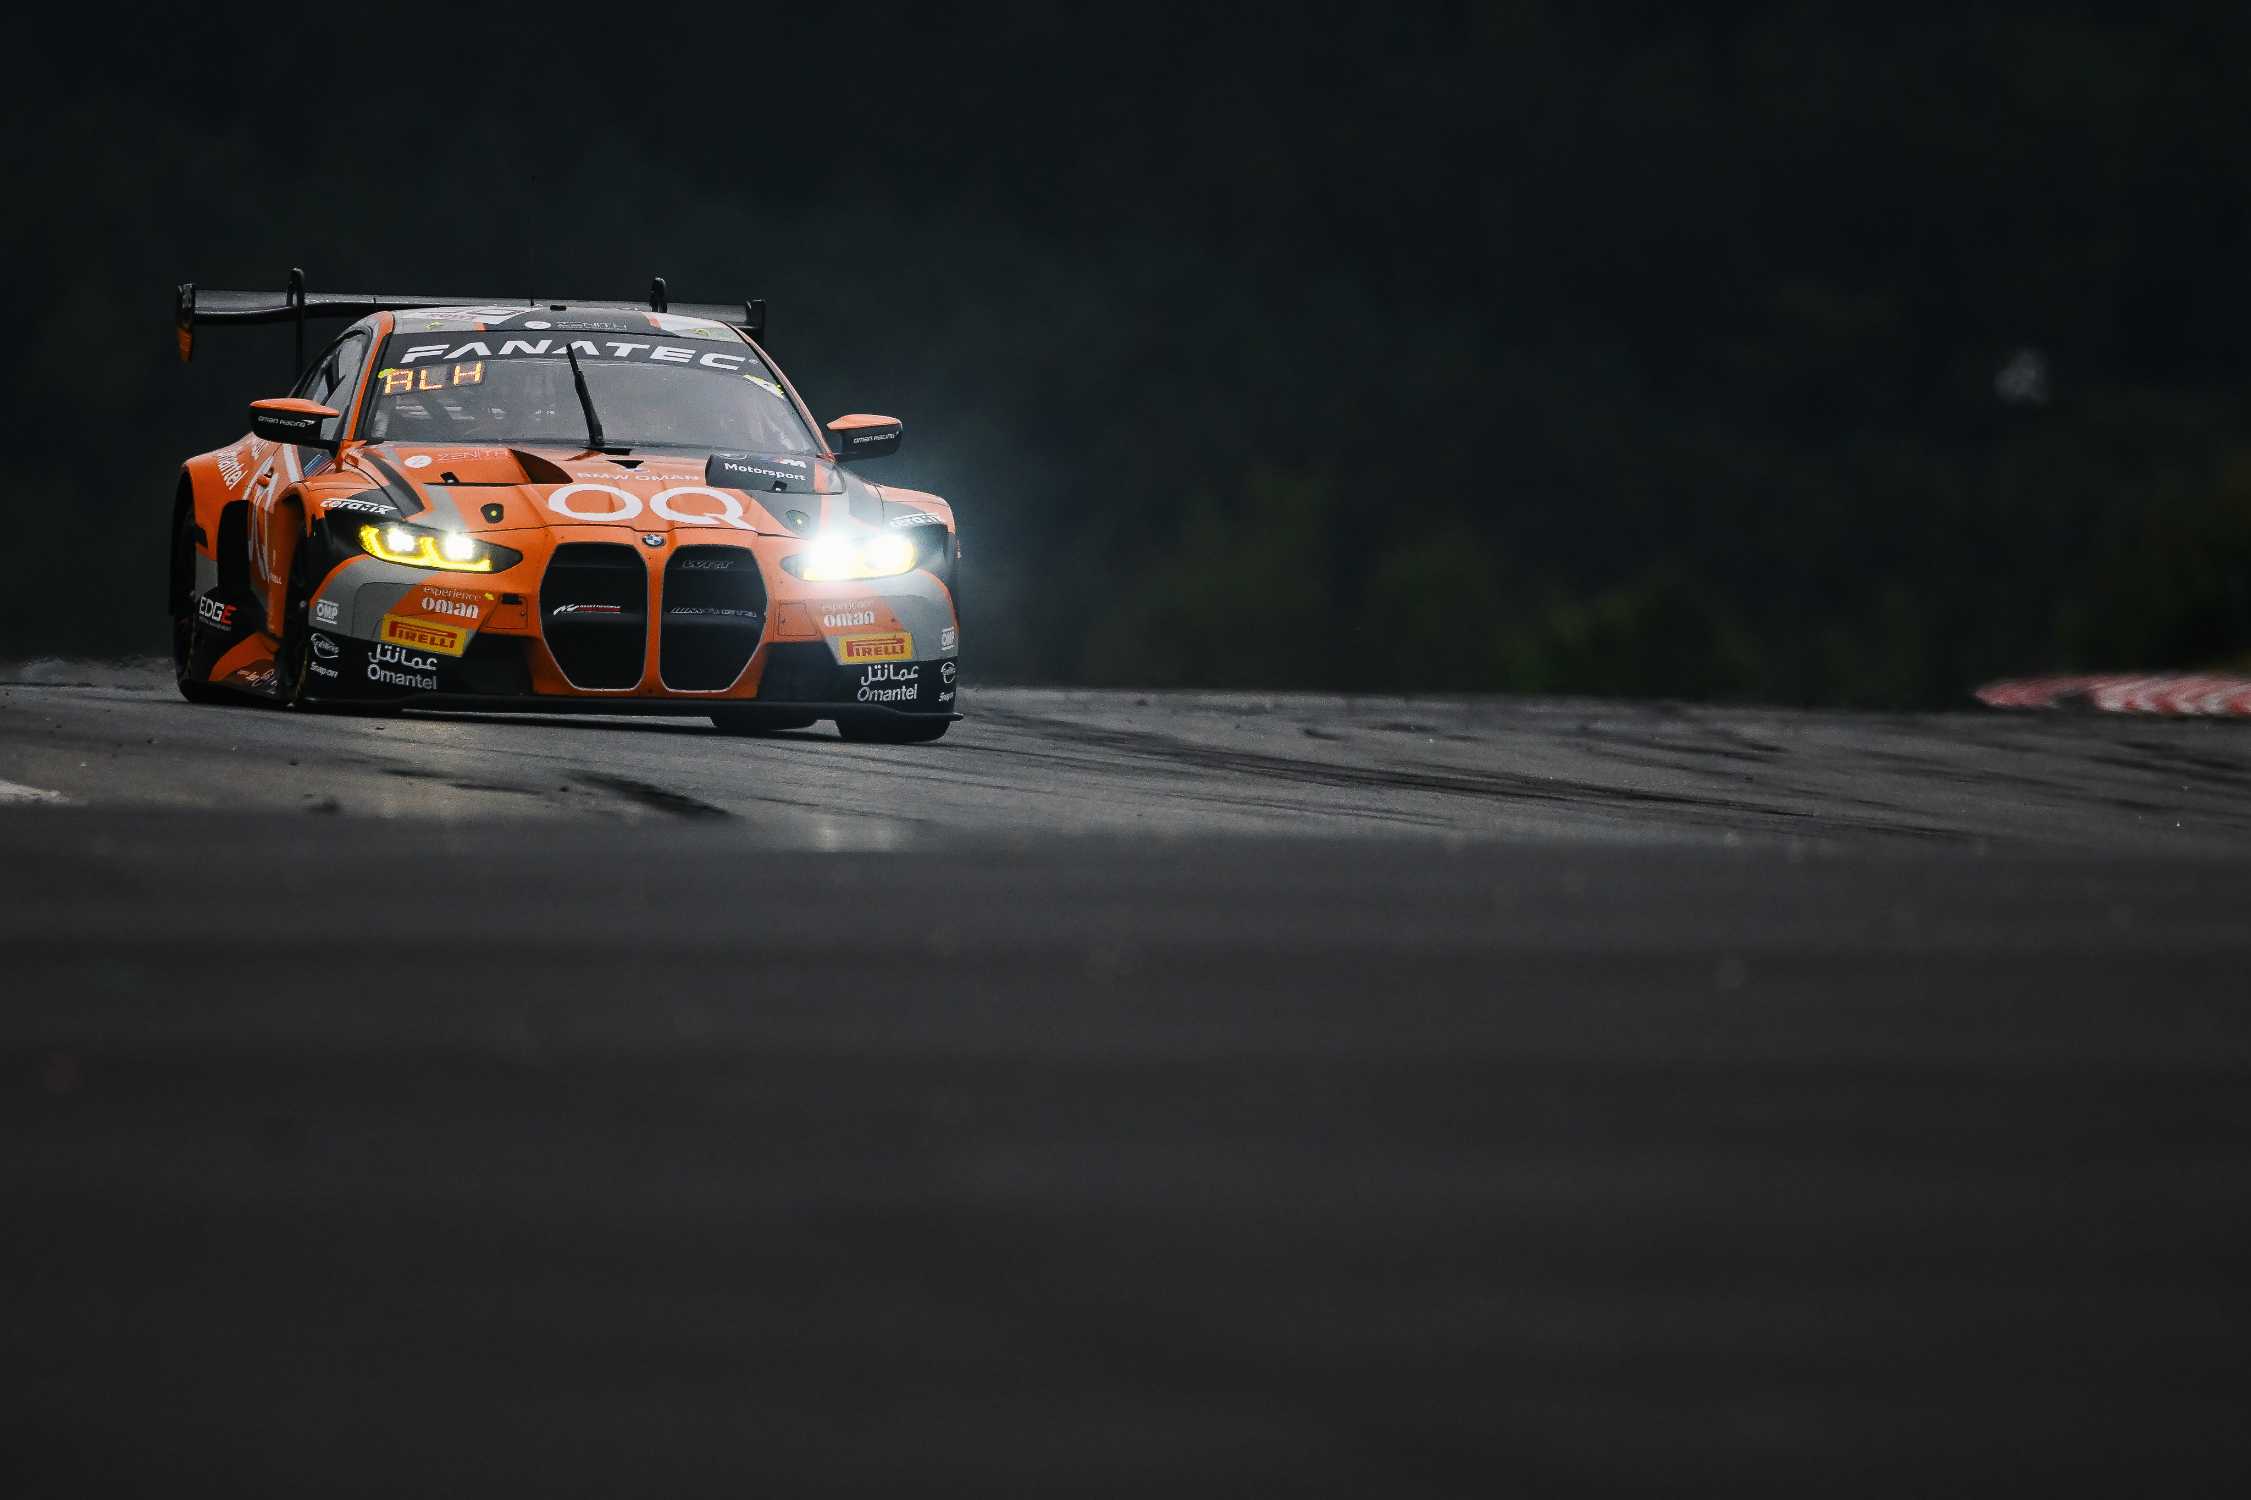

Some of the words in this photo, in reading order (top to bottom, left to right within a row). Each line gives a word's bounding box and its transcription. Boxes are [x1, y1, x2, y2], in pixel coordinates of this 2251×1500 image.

[400, 340, 746, 371] FANATEC
[384, 361, 484, 394] ALH
[724, 462, 807, 481] Motorsport
[547, 483, 758, 532] OQ
[422, 597, 479, 619] oman
[388, 620, 458, 649] PIRELLI
[845, 637, 904, 657] PIRELLI
[367, 663, 438, 690] Omantel
[857, 683, 918, 702] Omantel
